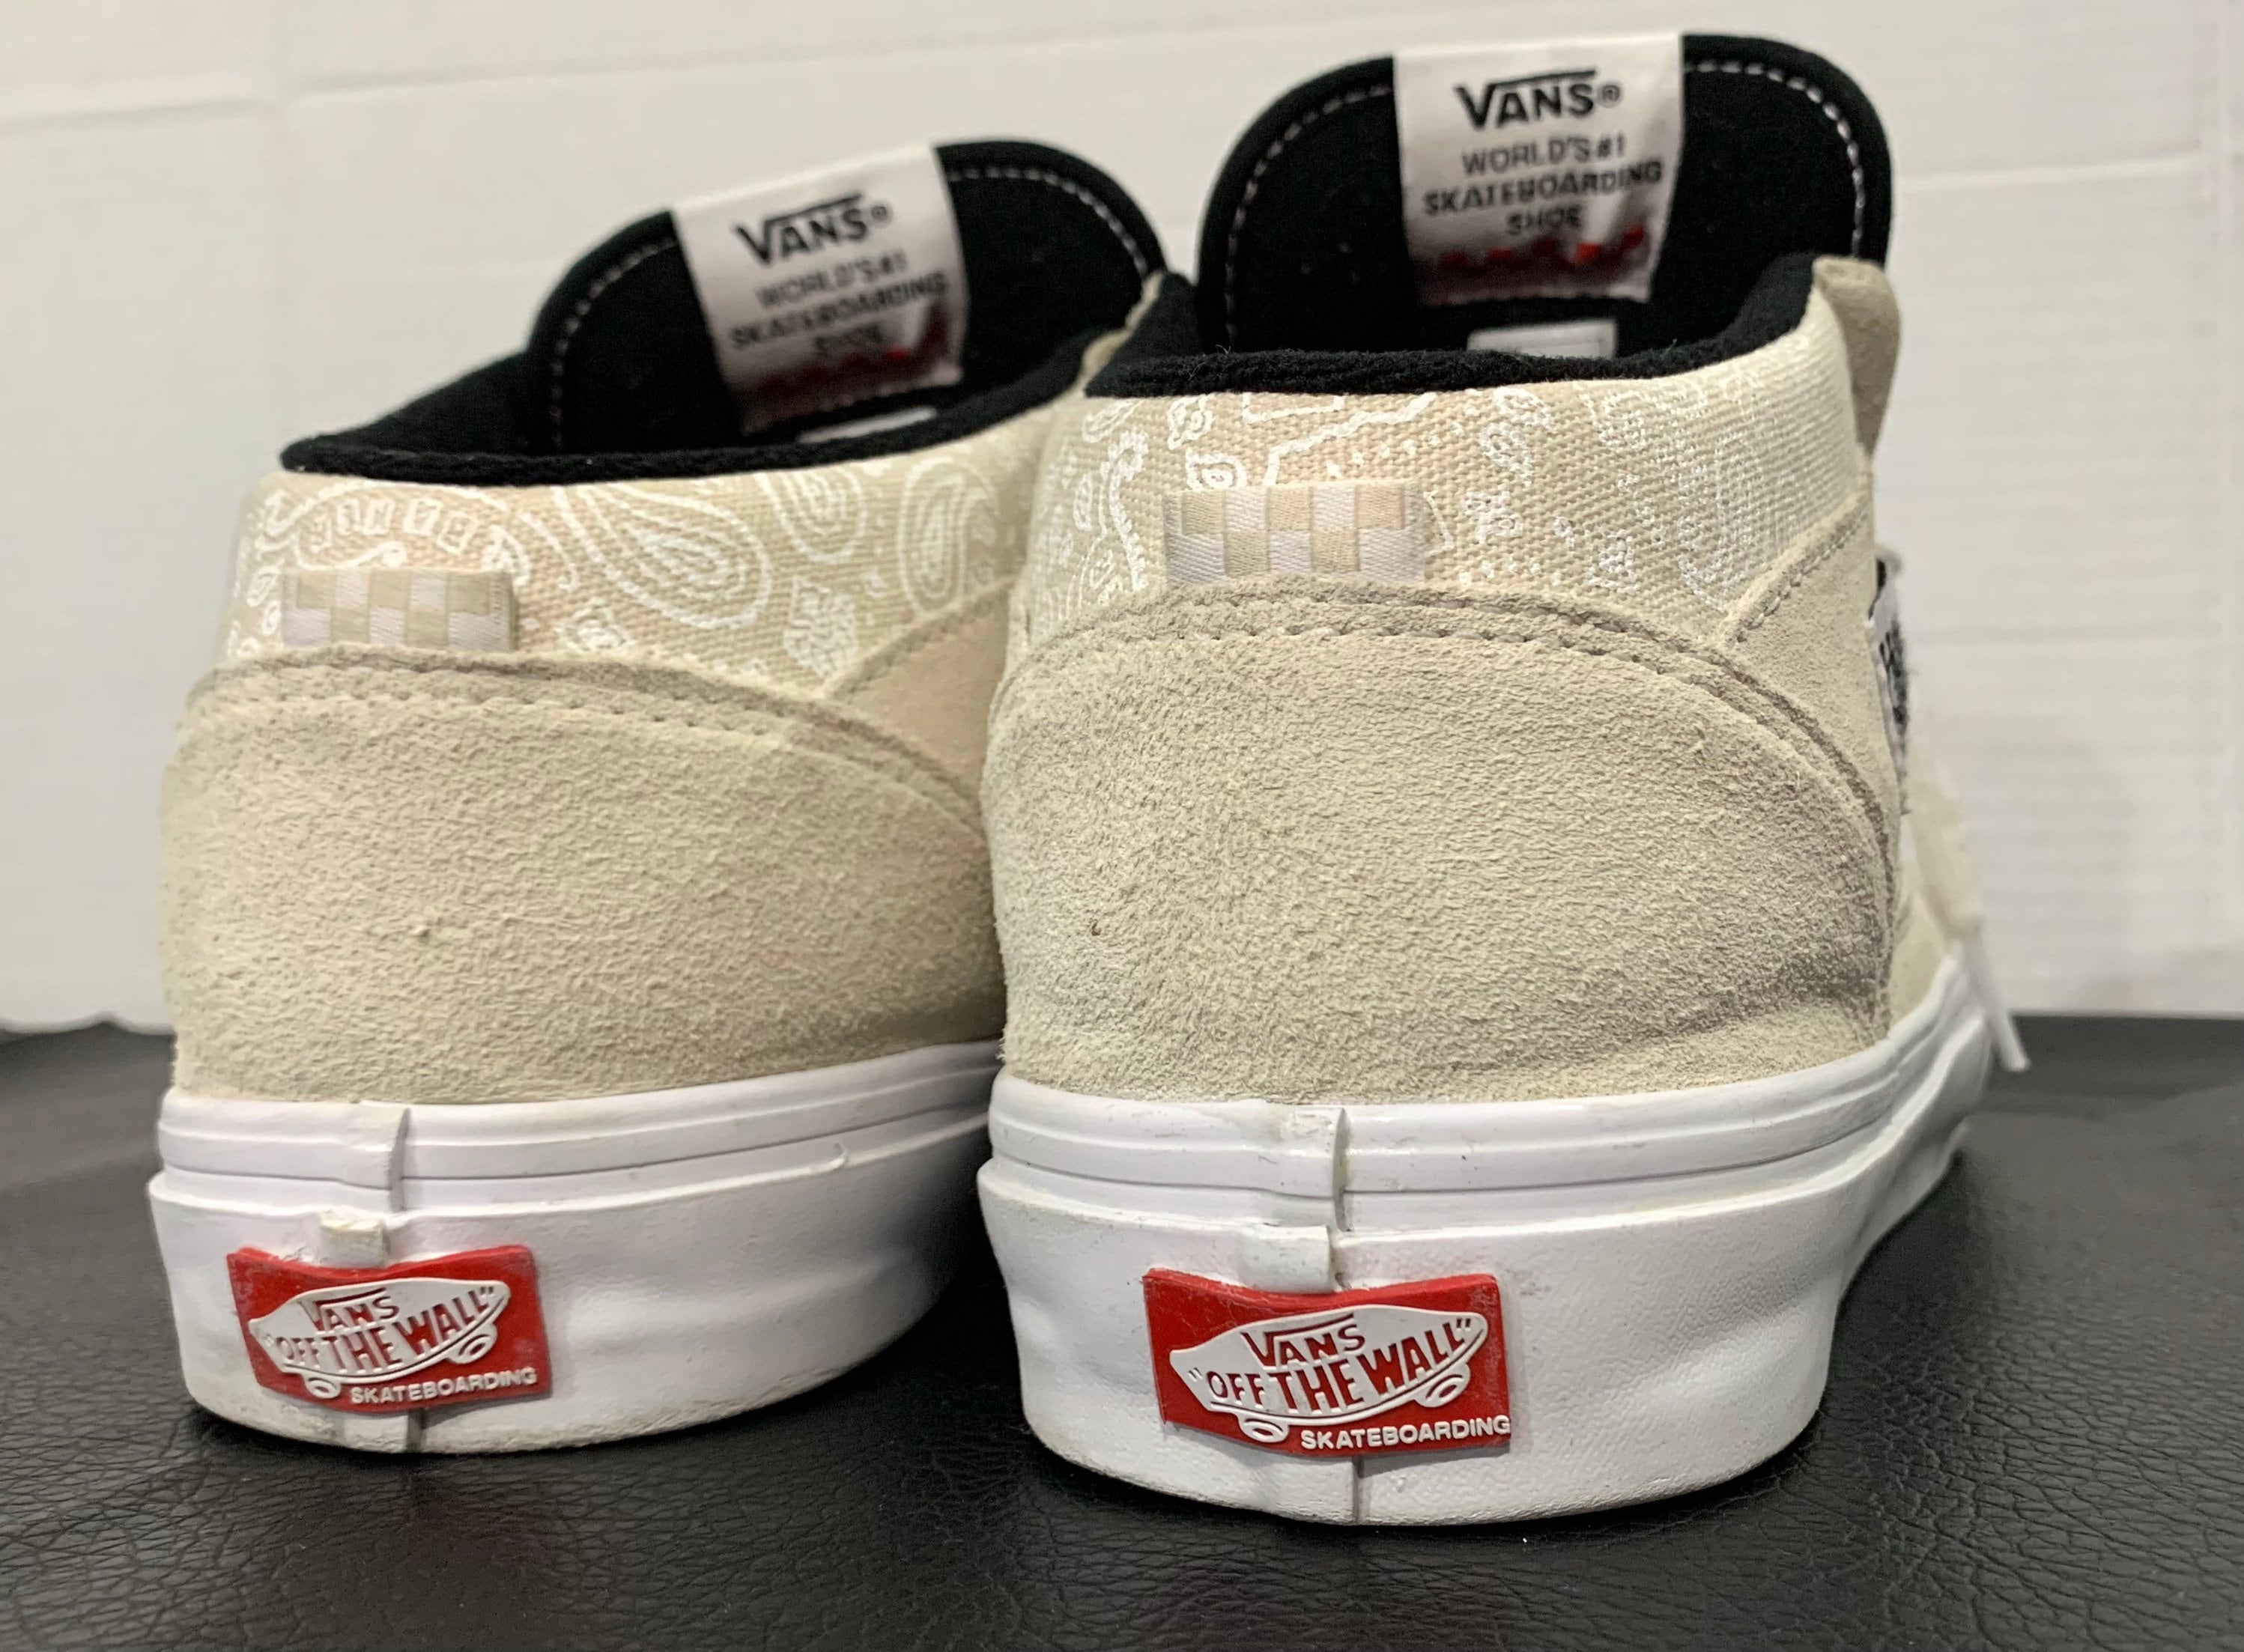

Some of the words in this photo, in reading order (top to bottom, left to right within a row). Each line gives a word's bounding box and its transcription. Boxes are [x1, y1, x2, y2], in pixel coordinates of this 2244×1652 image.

[1461, 136, 1591, 177] WORLD'S
[1424, 160, 1663, 216] SKATEBOARDING
[297, 1287, 401, 1334] VANS
[321, 1326, 404, 1374] THE
[1240, 1313, 1365, 1371] VANS
[351, 1366, 538, 1405] SKATEBOARDING
[1275, 1359, 1365, 1414] THE
[1300, 1414, 1511, 1451] SKATEBOARDING
